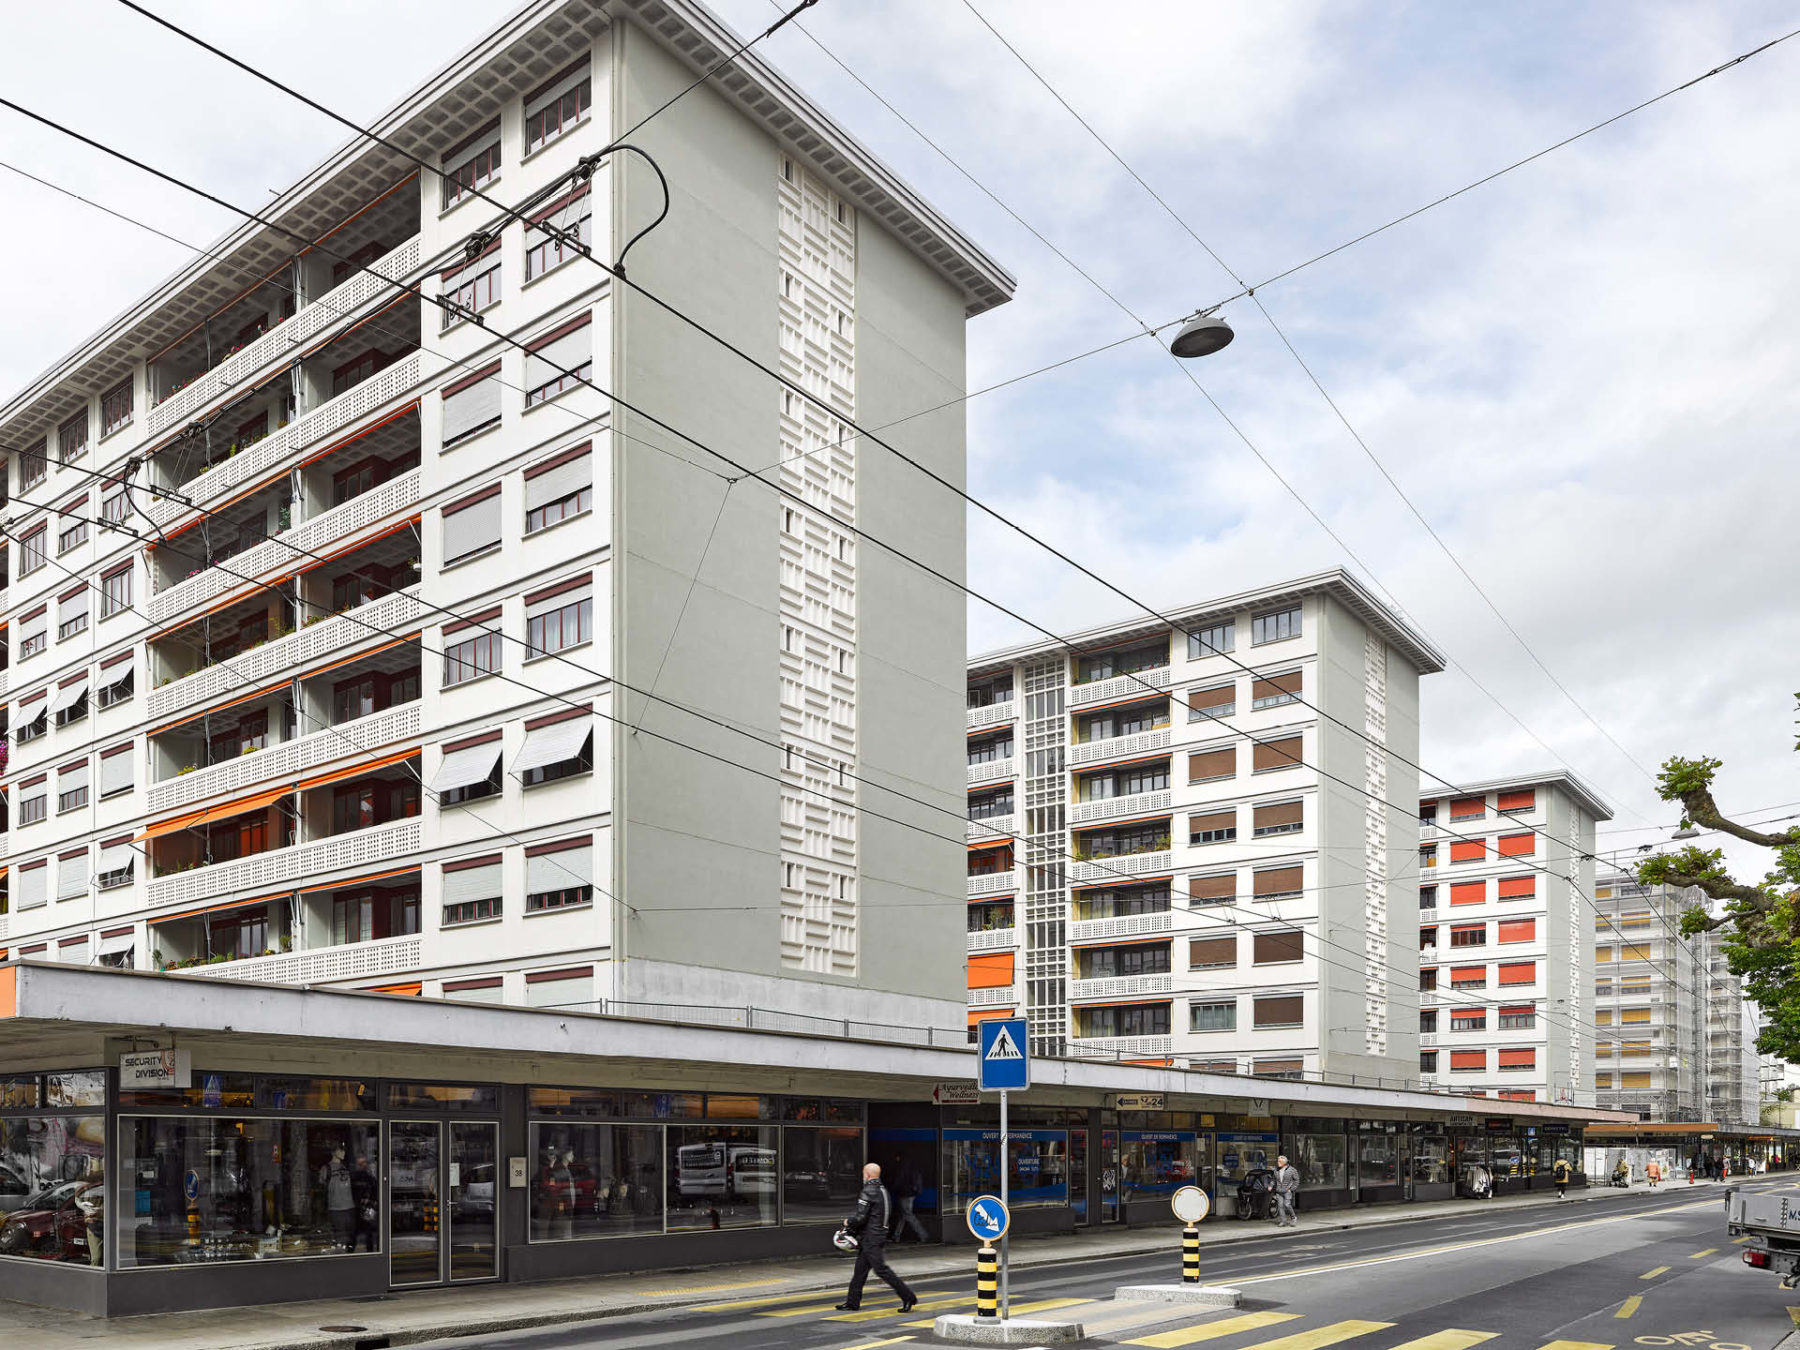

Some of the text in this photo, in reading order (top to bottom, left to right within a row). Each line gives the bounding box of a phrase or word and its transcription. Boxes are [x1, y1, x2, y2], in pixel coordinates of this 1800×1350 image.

[125, 1056, 162, 1066] SECURITY
[135, 1068, 169, 1079] DIVISION
[1151, 1098, 1163, 1106] 24
[515, 1169, 523, 1177] 38
